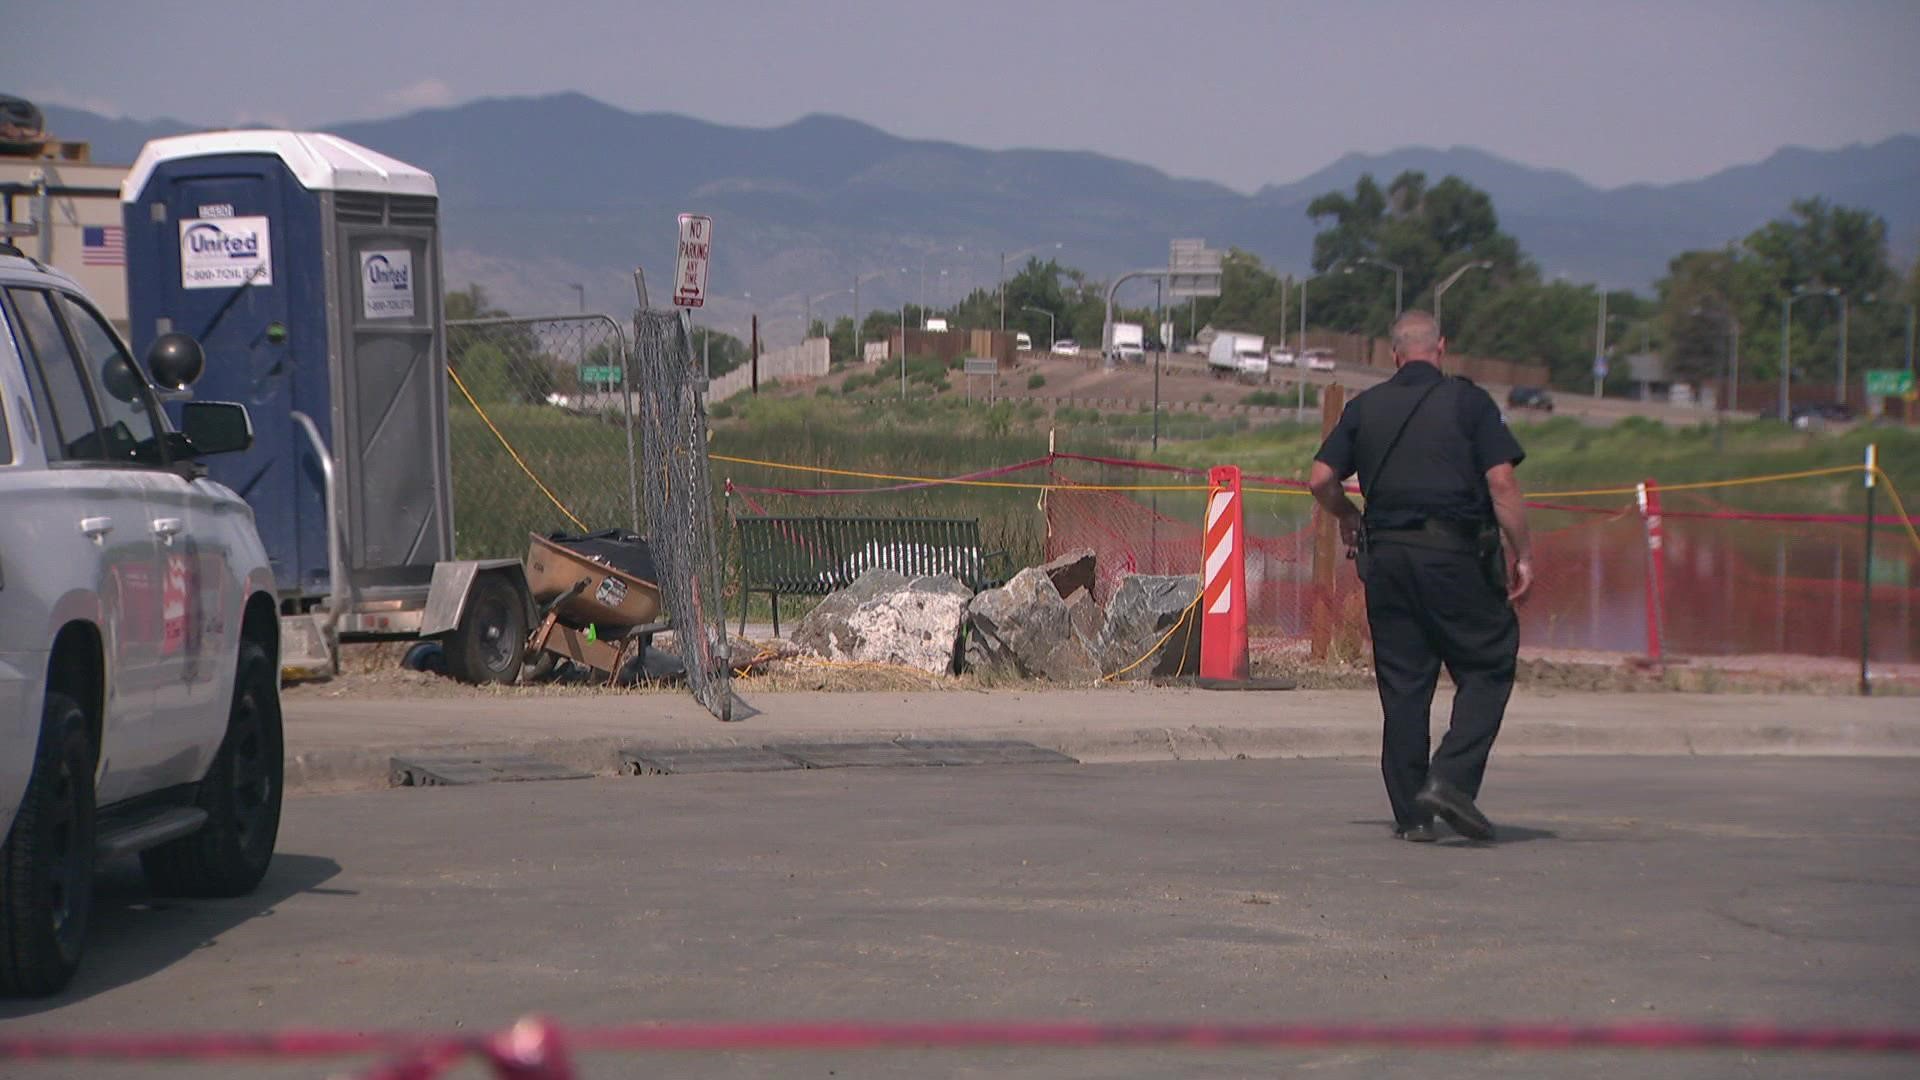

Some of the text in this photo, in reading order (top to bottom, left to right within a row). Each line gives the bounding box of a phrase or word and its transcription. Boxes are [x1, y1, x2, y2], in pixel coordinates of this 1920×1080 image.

[690, 221, 702, 239] NO
[190, 232, 257, 252] United
[680, 242, 708, 260] PARKING
[369, 264, 408, 284] United
[687, 261, 698, 272] ANY
[685, 273, 697, 285] TIME
